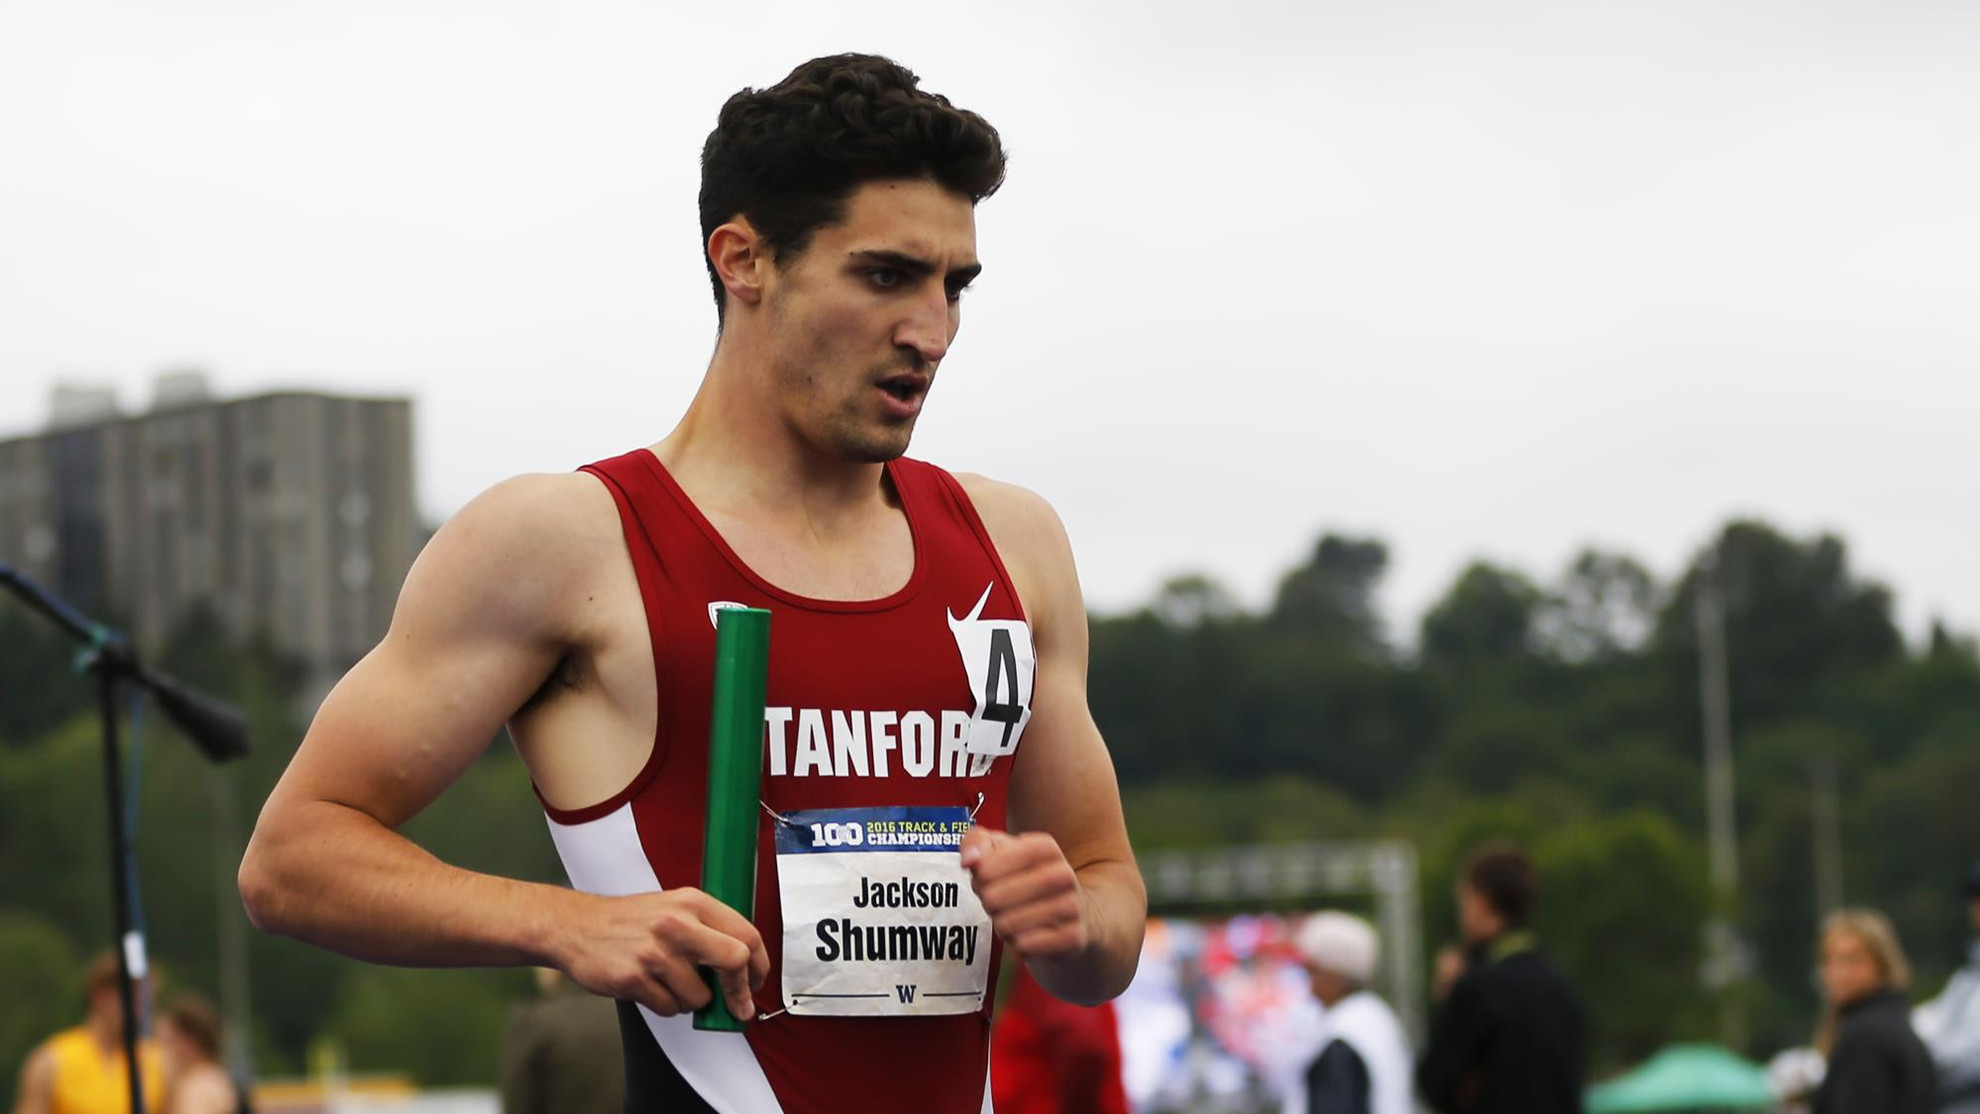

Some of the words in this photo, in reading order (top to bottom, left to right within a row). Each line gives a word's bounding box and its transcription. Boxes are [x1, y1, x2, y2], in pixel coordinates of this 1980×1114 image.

[981, 628, 1024, 748] 4
[764, 706, 992, 777] TANFOR
[810, 822, 864, 847] 100
[866, 821, 896, 833] 2016
[899, 821, 936, 833] TRACK
[940, 822, 947, 832] &
[951, 821, 970, 833] FIE
[866, 832, 965, 846] CHAMPIONSH
[853, 877, 958, 908] Jackson
[815, 918, 978, 966] Shumway
[895, 985, 917, 1004] W
